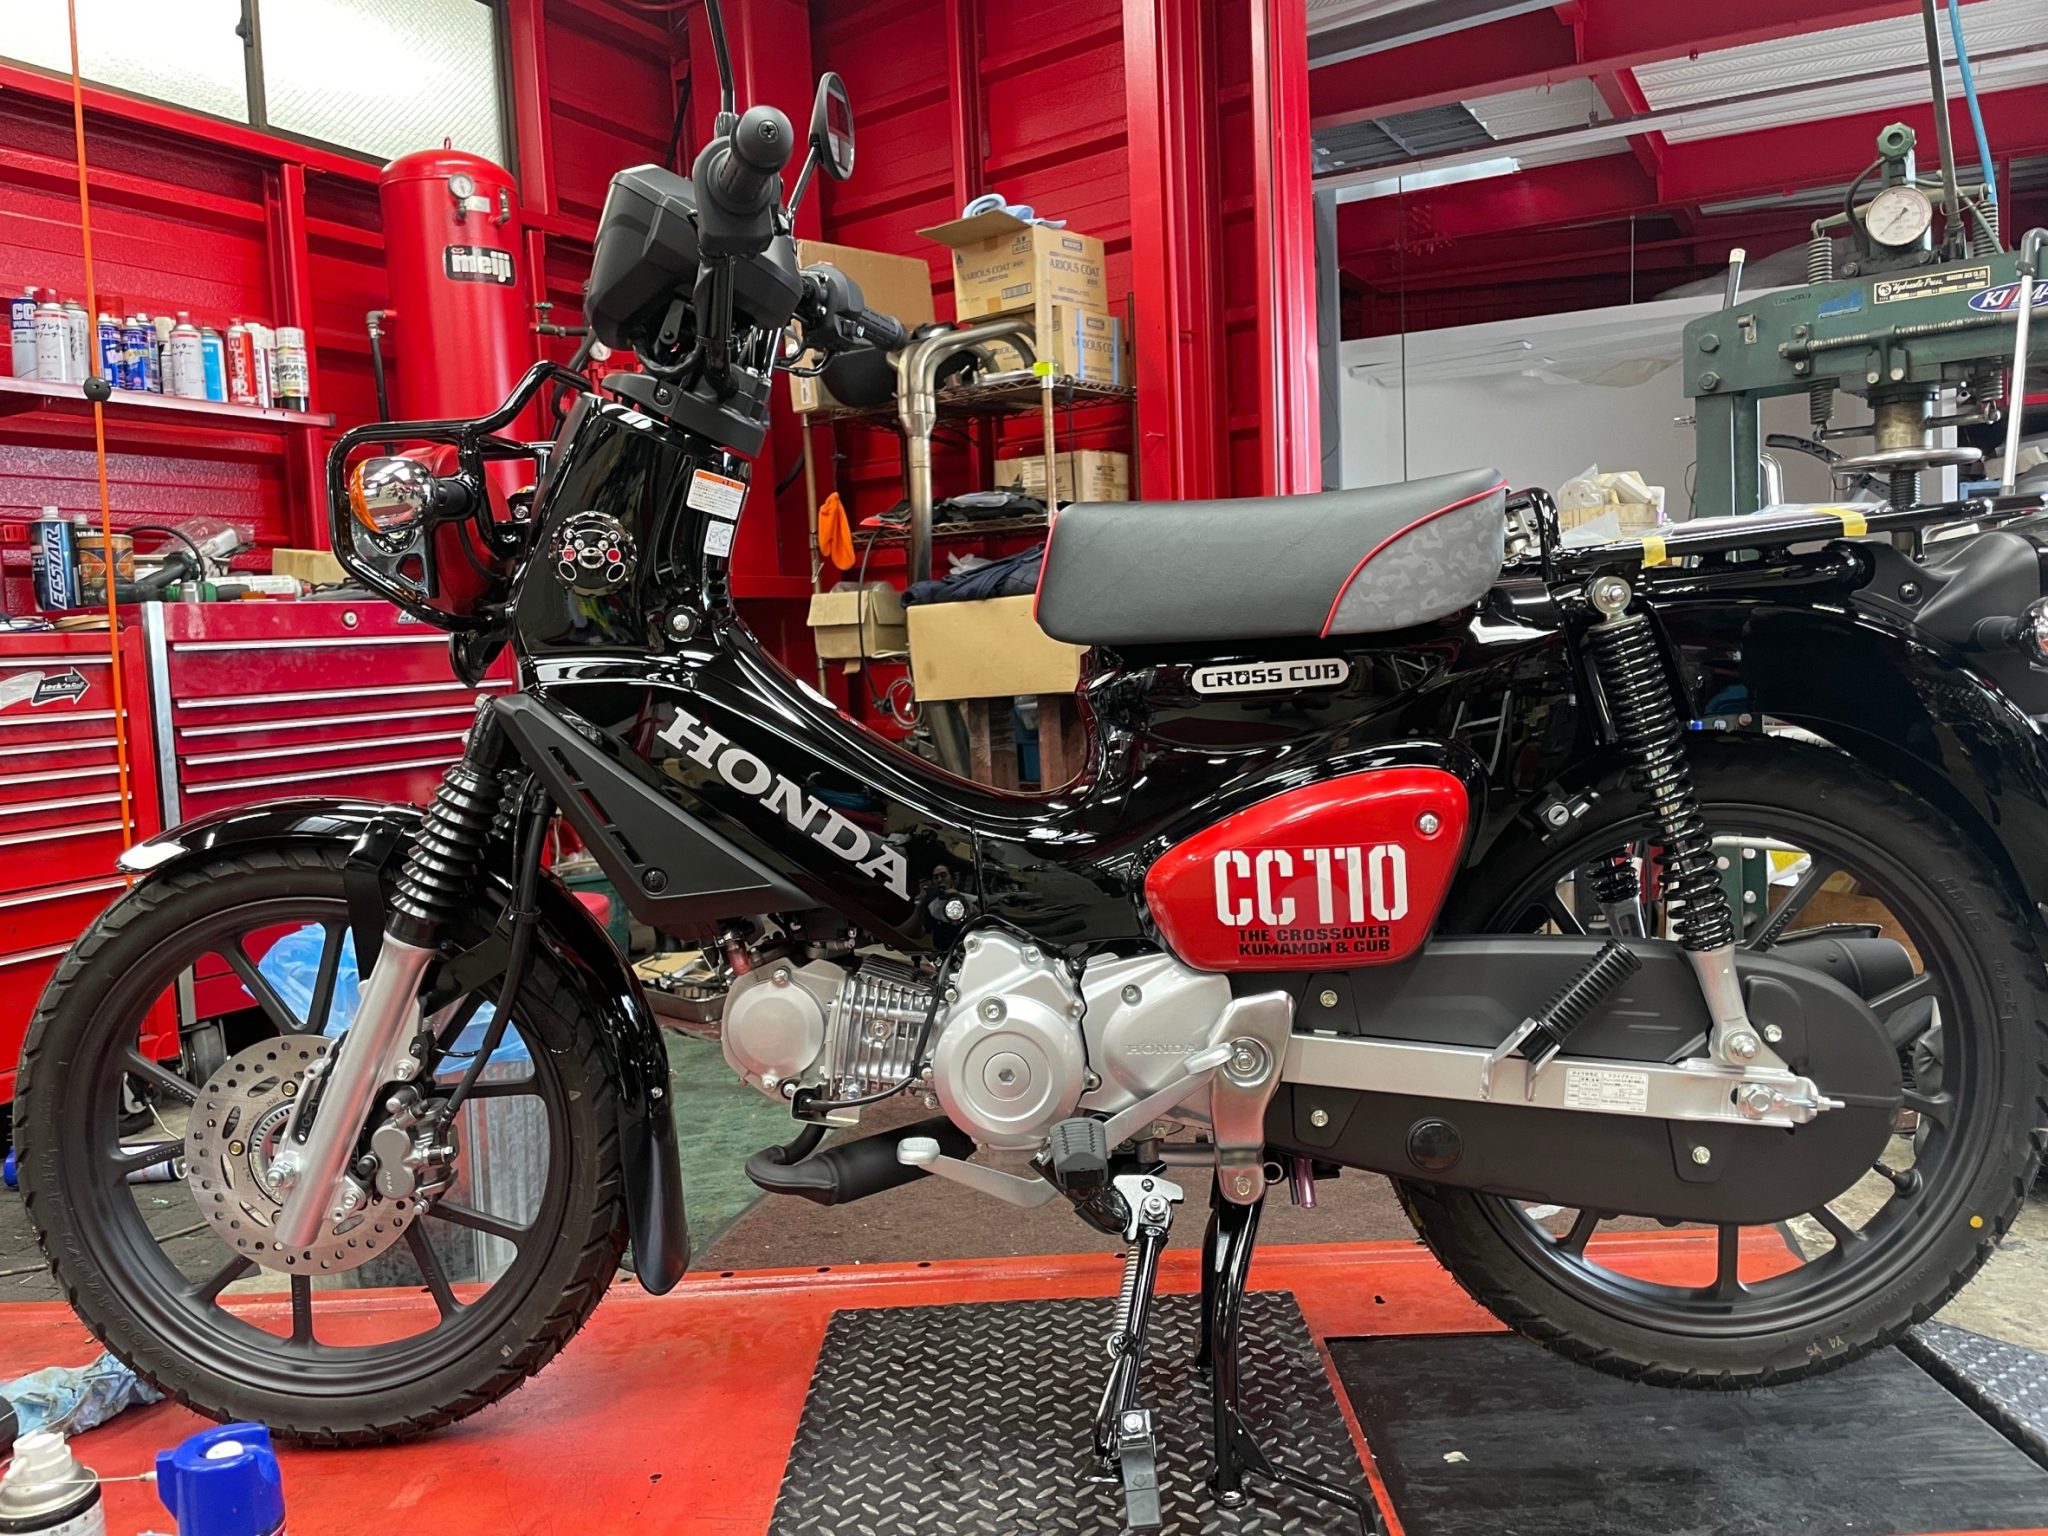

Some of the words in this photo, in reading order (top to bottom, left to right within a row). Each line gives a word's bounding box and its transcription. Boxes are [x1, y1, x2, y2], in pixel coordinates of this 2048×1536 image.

[452, 250, 512, 282] meiji
[1049, 258, 1080, 274] ARIOUS
[46, 523, 67, 611] ECSTAR
[1201, 668, 1283, 689] CROSS
[1288, 663, 1341, 682] CUB
[656, 706, 911, 902] HONDA
[1237, 929, 1272, 942] THE
[1276, 925, 1390, 941] CROSSOVER
[1238, 941, 1332, 956] KUMAMON
[1335, 940, 1350, 953] &
[1353, 939, 1391, 953] CUB
[1125, 1044, 1196, 1056] HONDA
